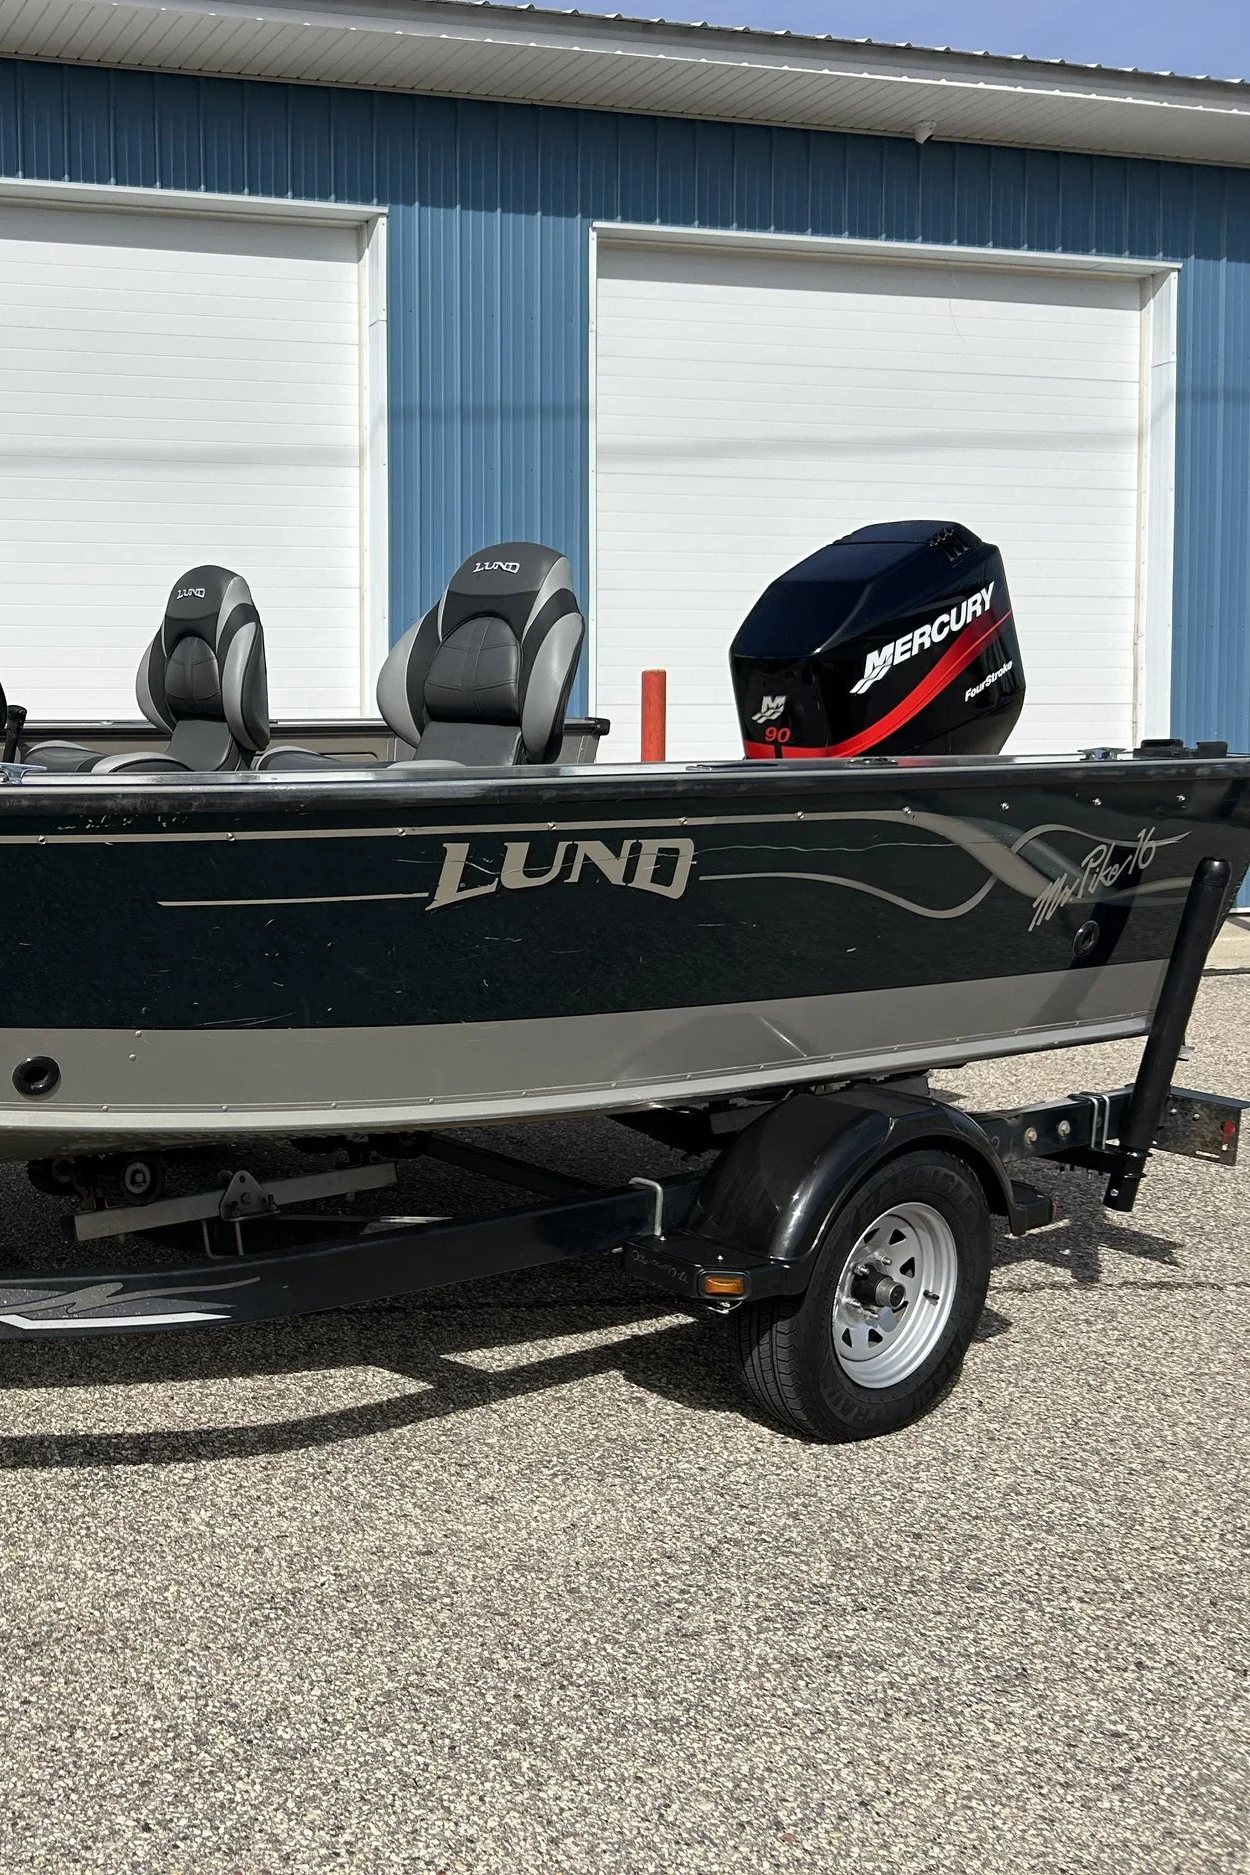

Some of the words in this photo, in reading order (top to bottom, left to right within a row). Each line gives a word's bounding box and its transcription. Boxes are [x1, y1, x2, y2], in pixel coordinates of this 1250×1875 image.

[472, 561, 520, 574] LUND
[176, 588, 206, 600] LUND
[850, 581, 995, 693] MERCURY
[964, 660, 1013, 702] FourStroke
[765, 726, 791, 743] 90
[425, 838, 695, 911] LUND
[1077, 842, 1133, 899] Pike
[1128, 826, 1157, 875] 16
